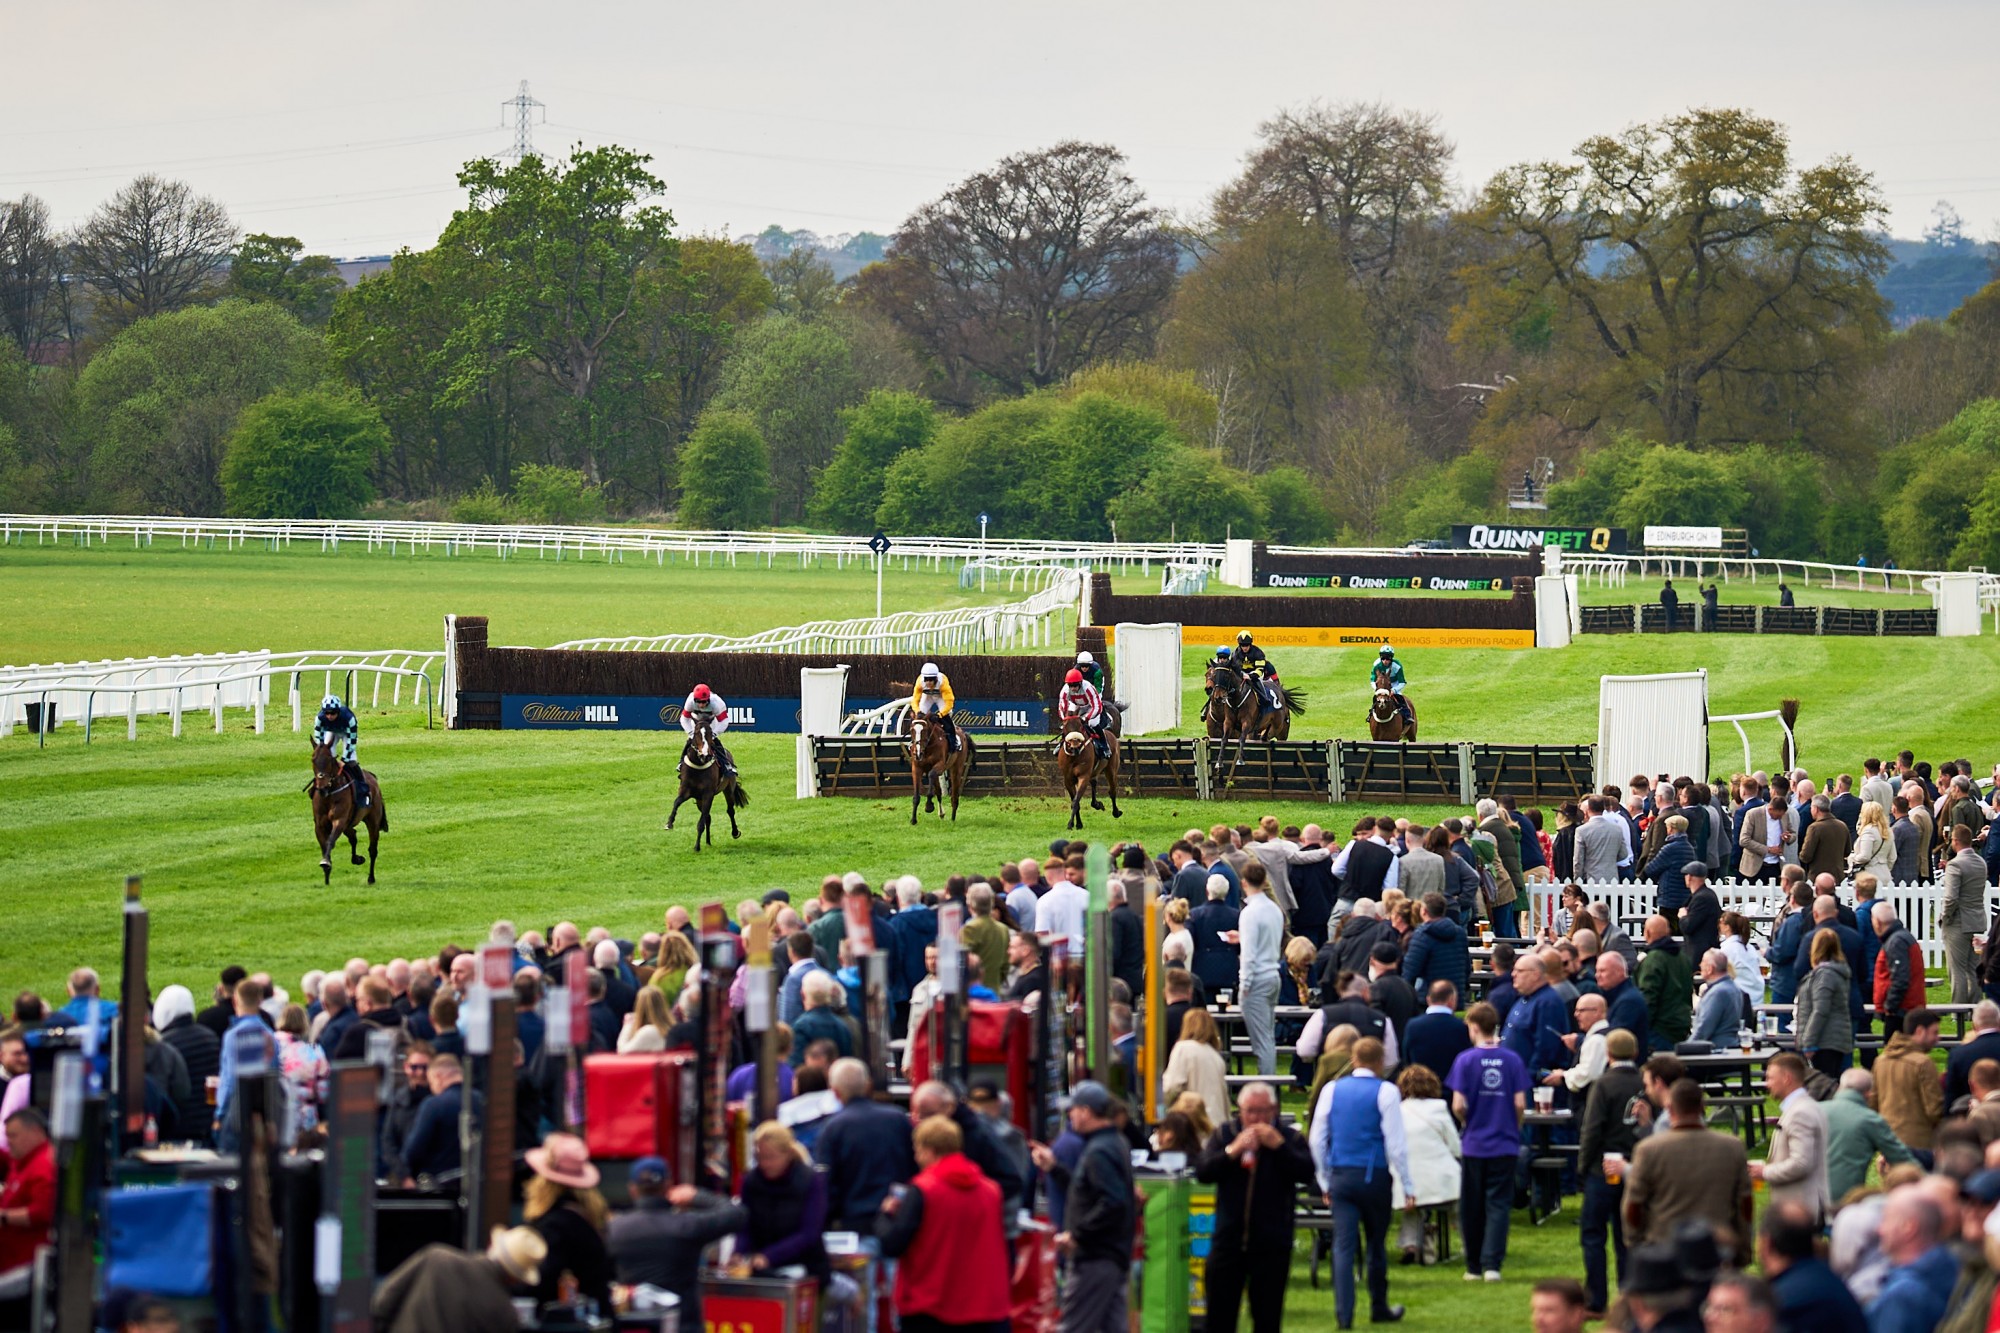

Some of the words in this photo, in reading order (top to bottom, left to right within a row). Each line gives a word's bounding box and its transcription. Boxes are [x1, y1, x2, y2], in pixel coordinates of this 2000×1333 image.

[980, 515, 988, 523] 3
[1469, 525, 1587, 549] QUINNBET
[876, 539, 884, 551] 2
[1269, 574, 1329, 588] QUINNBET
[1349, 575, 1410, 589] QUINNBET
[1429, 576, 1490, 590] QUINNBET
[1182, 634, 1215, 643] HAVINGS
[1277, 635, 1308, 643] RACING
[1340, 636, 1389, 644] BEDMAX
[1391, 637, 1431, 645] SHAVINGS
[1439, 638, 1491, 646] SUPPORTING
[1493, 638, 1523, 646] RACING
[522, 702, 584, 723] William
[584, 705, 618, 721] HILL
[953, 709, 994, 726] illiam
[995, 710, 1029, 727] HILL
